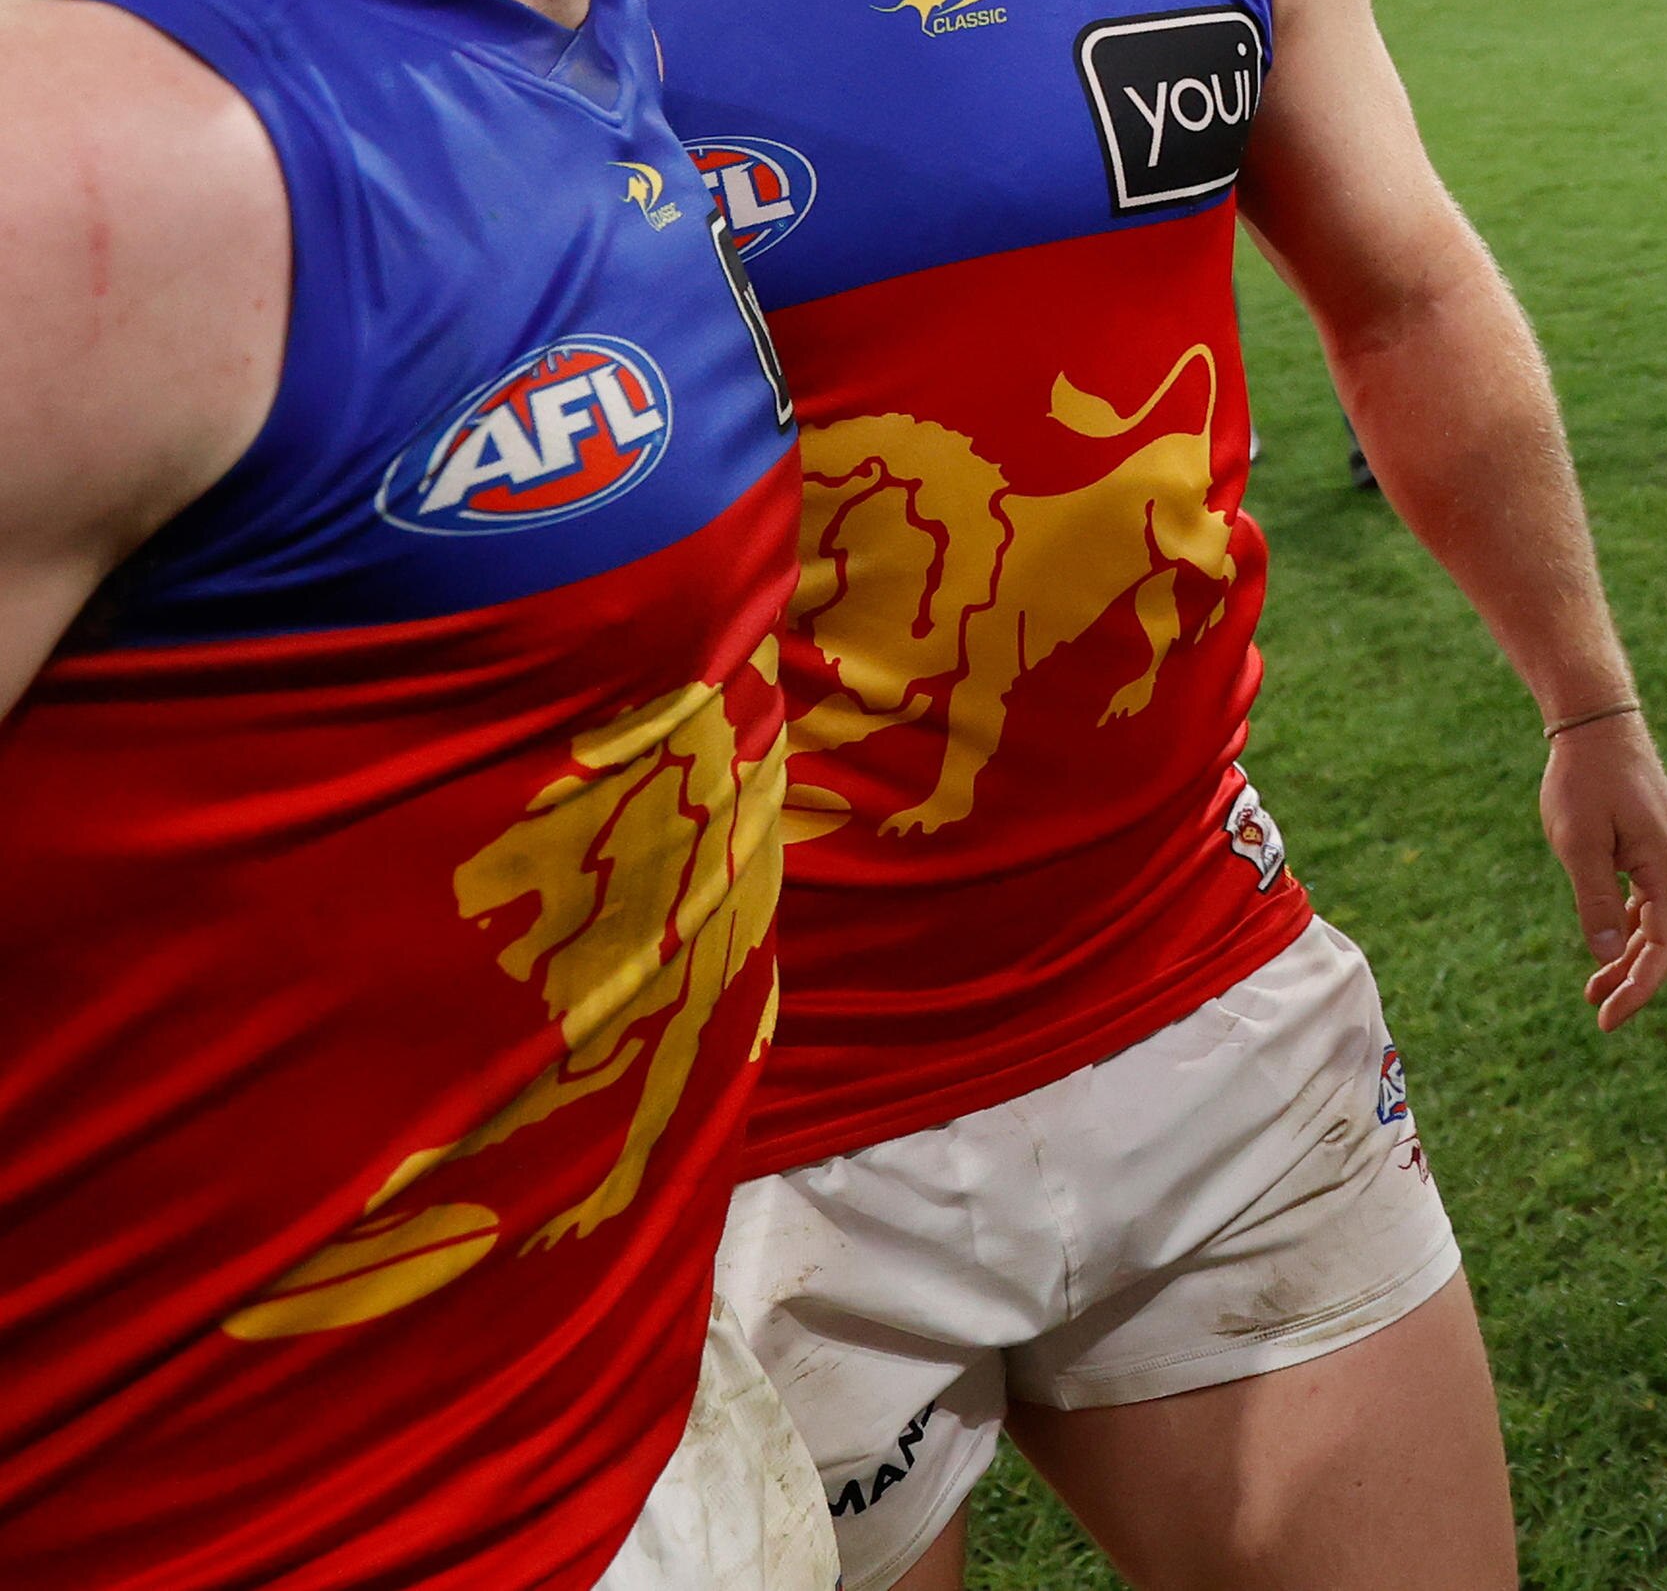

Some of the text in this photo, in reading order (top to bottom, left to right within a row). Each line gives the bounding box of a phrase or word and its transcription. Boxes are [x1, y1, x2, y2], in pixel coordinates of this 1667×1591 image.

[933, 7, 1007, 35] CLASSIC
[1124, 42, 1251, 168] youi
[418, 361, 665, 516] AFL
